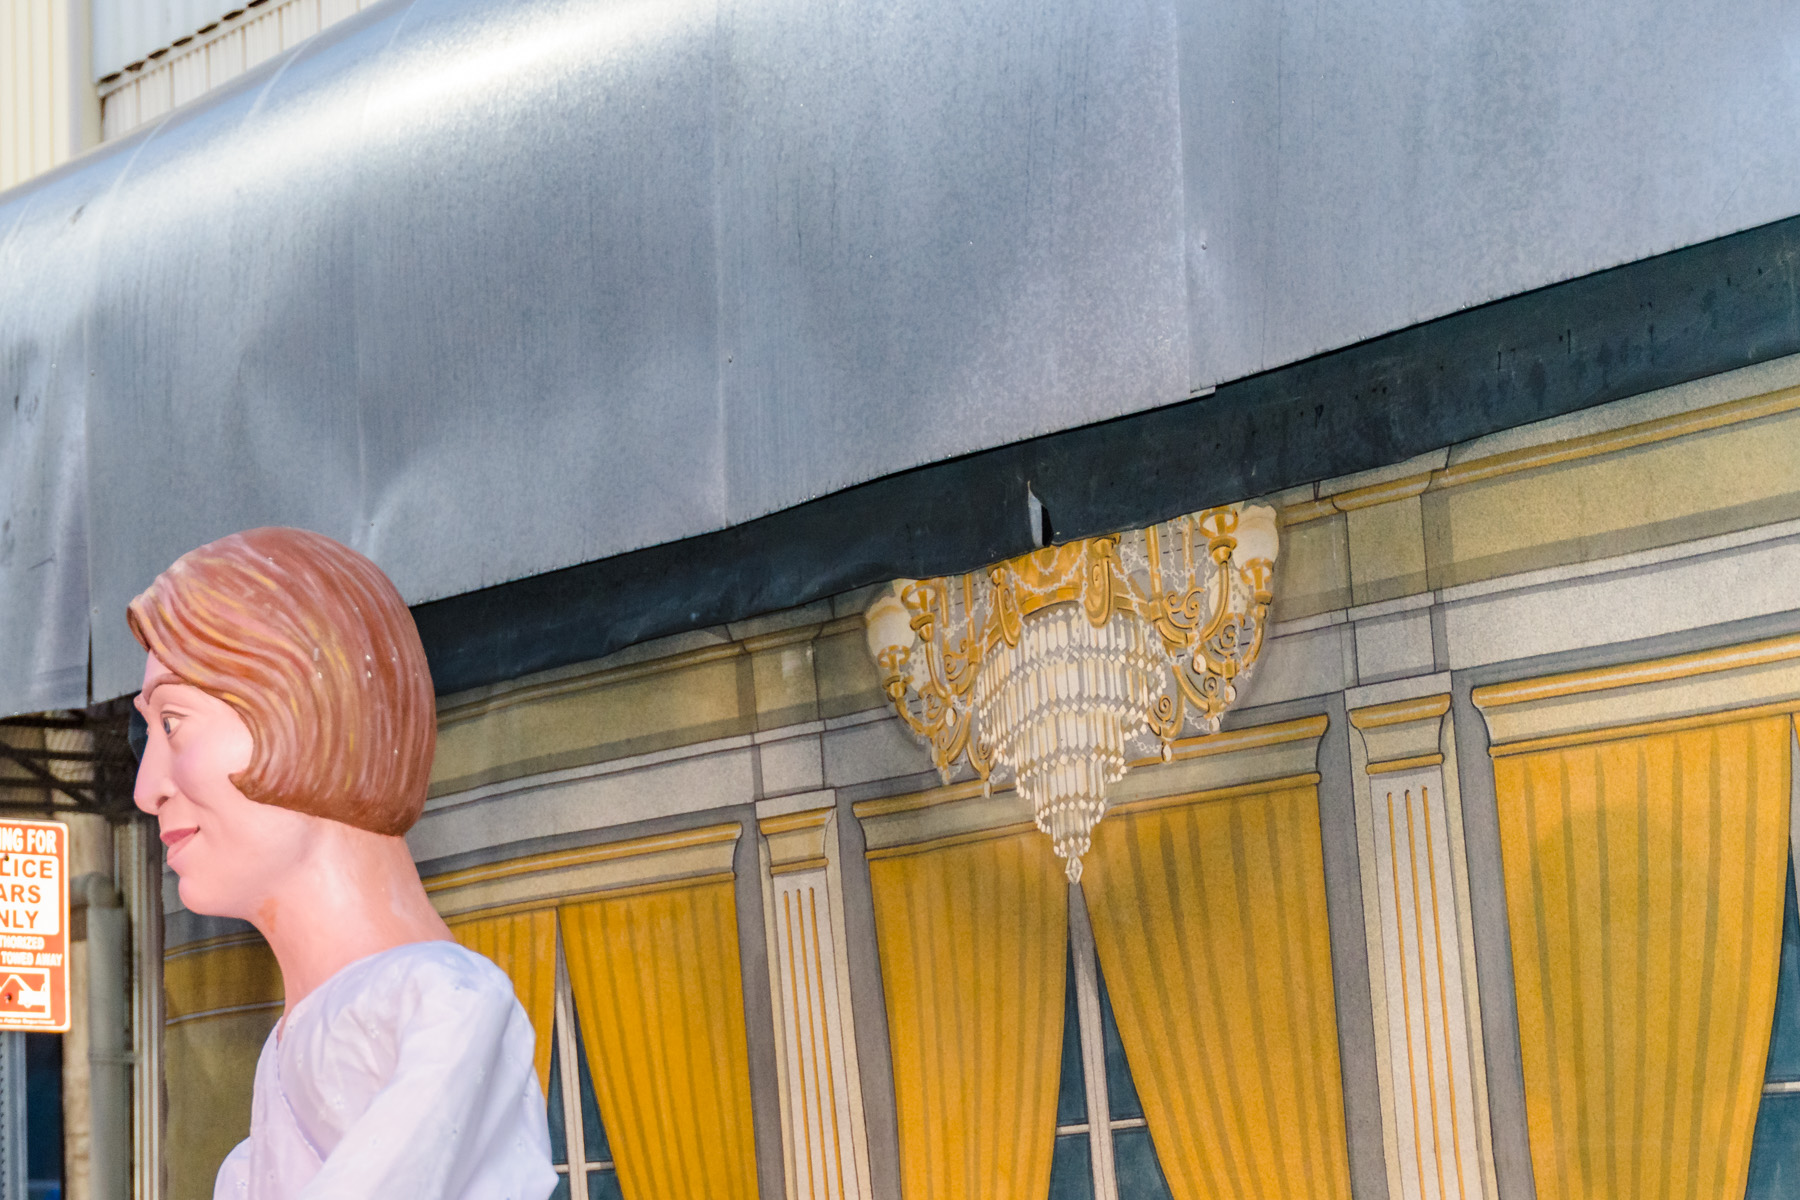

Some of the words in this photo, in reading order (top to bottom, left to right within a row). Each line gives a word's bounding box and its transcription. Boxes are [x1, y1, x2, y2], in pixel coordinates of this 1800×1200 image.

[27, 828, 57, 854] FOR
[0, 950, 34, 966] TOWED
[35, 952, 63, 967] AWAY
